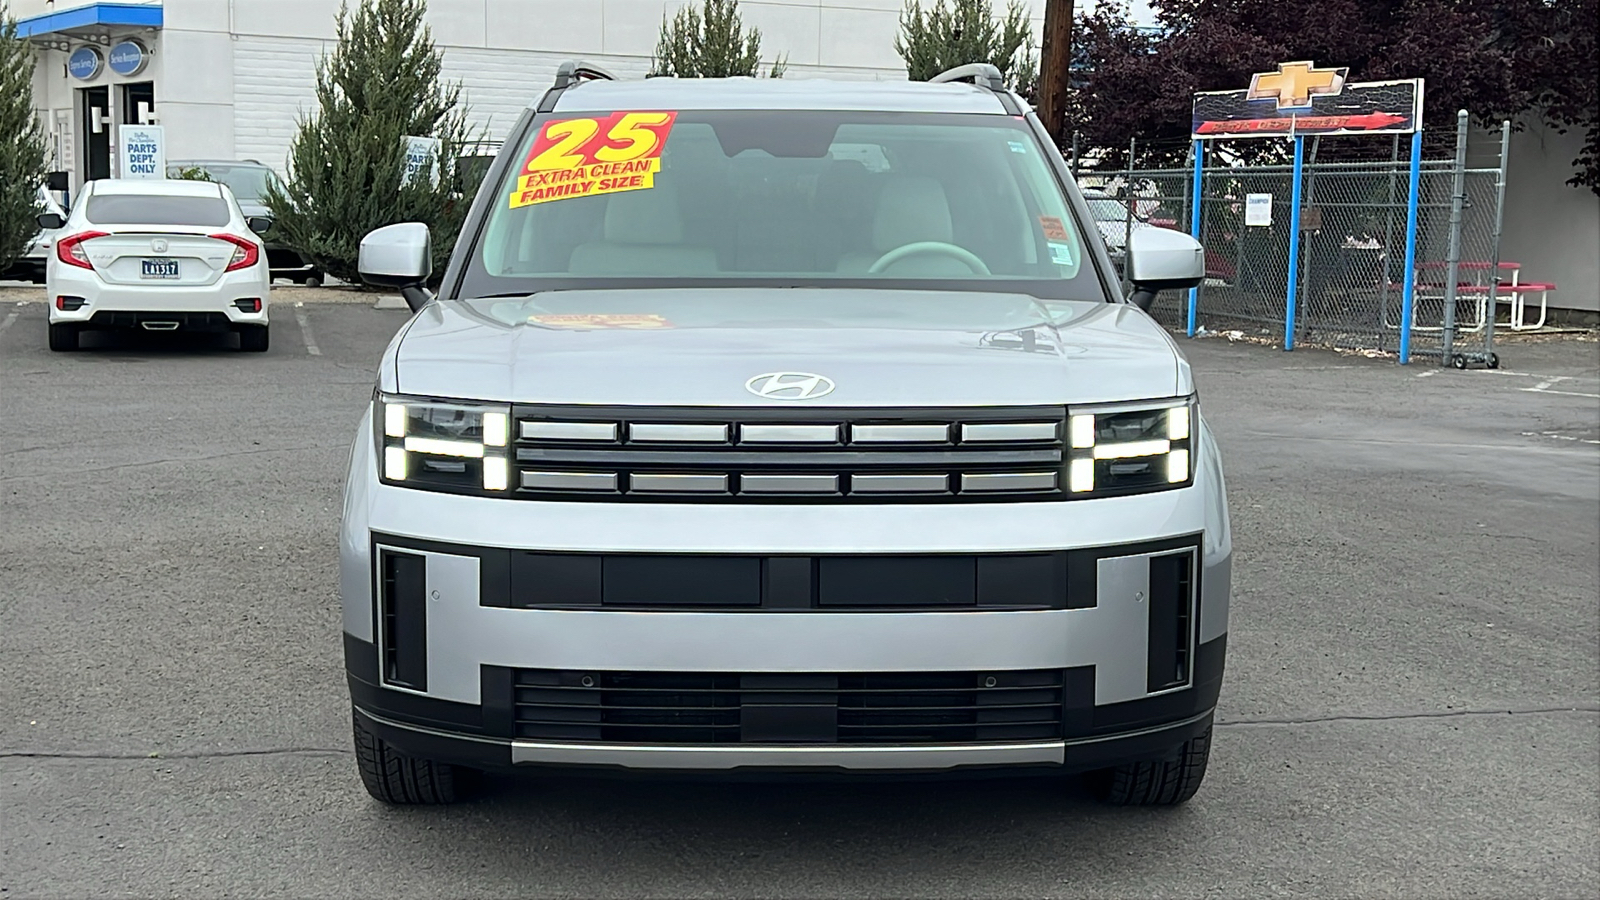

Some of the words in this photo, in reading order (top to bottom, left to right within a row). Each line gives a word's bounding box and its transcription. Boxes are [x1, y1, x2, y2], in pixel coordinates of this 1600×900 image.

[127, 143, 157, 153] PARTS
[528, 113, 671, 171] 25
[130, 154, 155, 163] DEPT.
[130, 164, 155, 173] ONLY
[525, 168, 588, 188] EXTRA
[590, 160, 652, 177] CLEAN
[520, 181, 596, 204] FAMILY
[597, 175, 645, 191] SIZE
